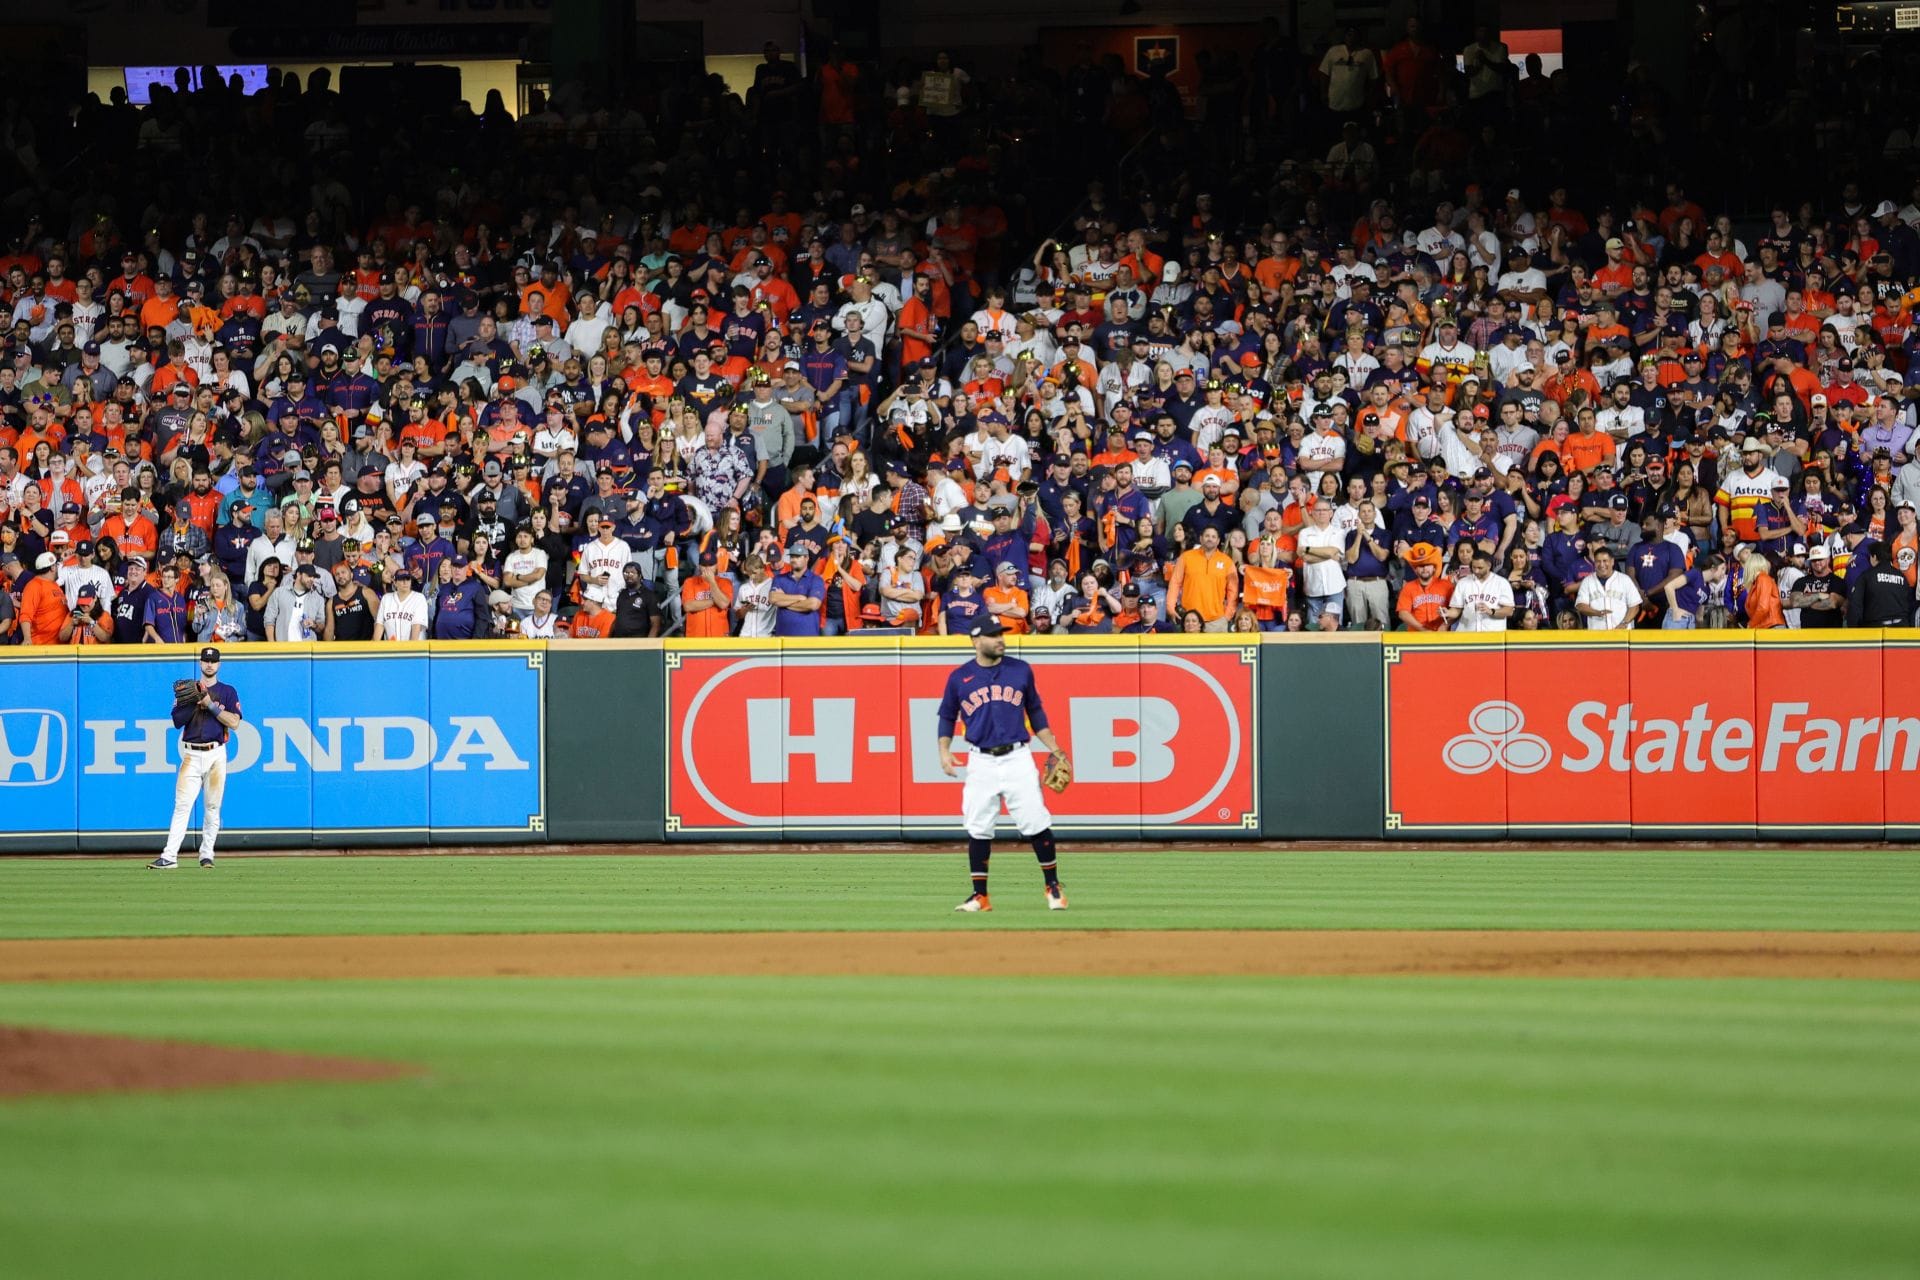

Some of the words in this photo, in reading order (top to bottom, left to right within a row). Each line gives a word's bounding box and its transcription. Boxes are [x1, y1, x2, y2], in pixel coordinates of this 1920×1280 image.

[229, 334, 255, 343] ASTROS
[1434, 355, 1464, 366] Astros
[1200, 416, 1227, 429] ASTROS
[89, 481, 118, 496] ASTRO
[1734, 485, 1767, 496] Astros
[588, 558, 621, 570] ASTROS
[1877, 572, 1904, 586] SECURITY
[1464, 593, 1497, 605] ASTROS
[961, 685, 1023, 716] ASTROS
